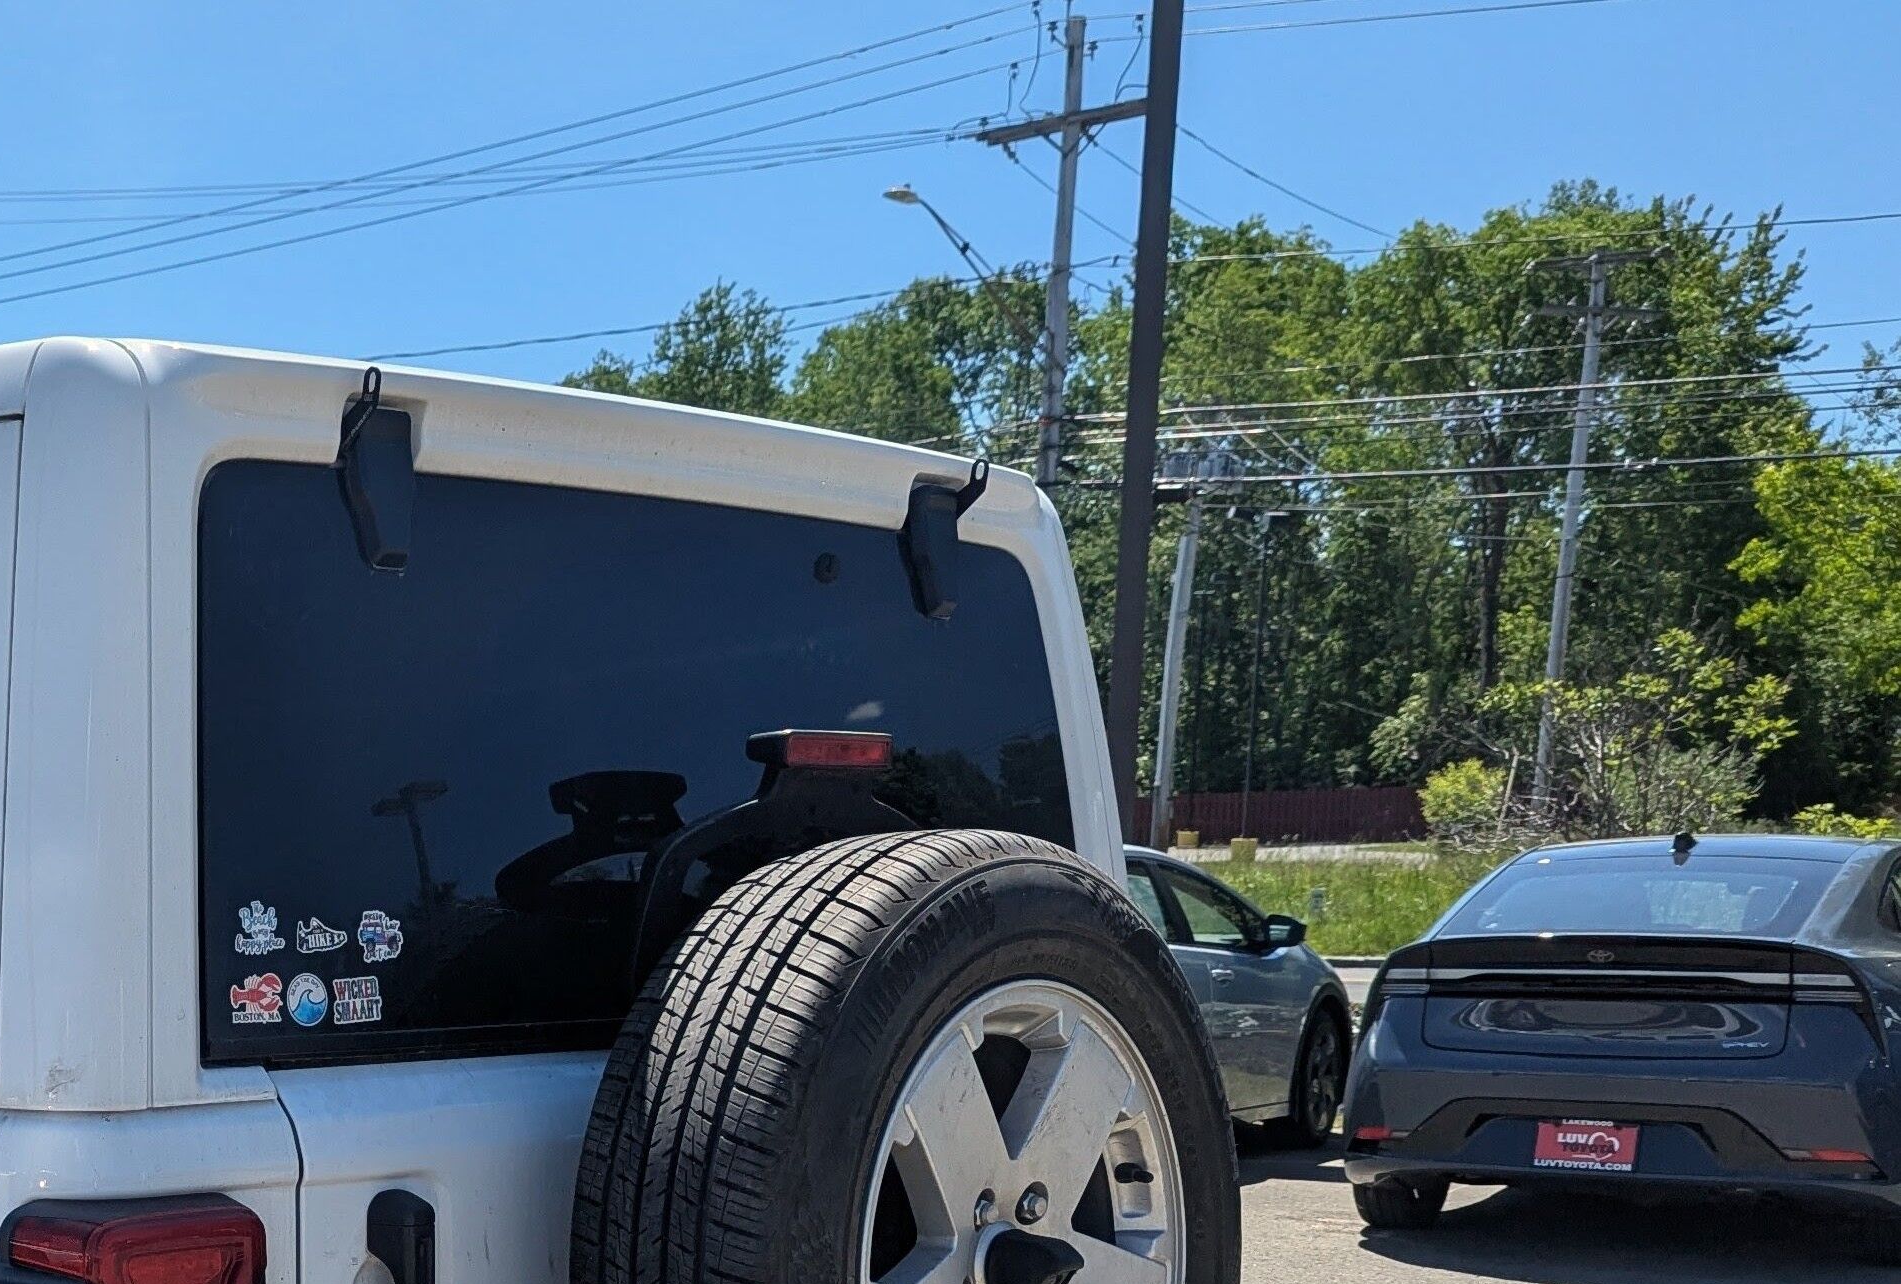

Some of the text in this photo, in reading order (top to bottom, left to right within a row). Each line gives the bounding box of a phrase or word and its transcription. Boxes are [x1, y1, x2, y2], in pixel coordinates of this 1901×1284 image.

[239, 908, 277, 931] Beach
[235, 935, 262, 953] happy
[308, 933, 332, 948] HIKE
[335, 979, 377, 1001] WICKED
[268, 1012, 280, 1021] MA
[1562, 1118, 1614, 1126] LAKEWOOD
[1557, 1132, 1589, 1144] LUV
[1533, 1158, 1632, 1172] LUVTOYOTA.COM
